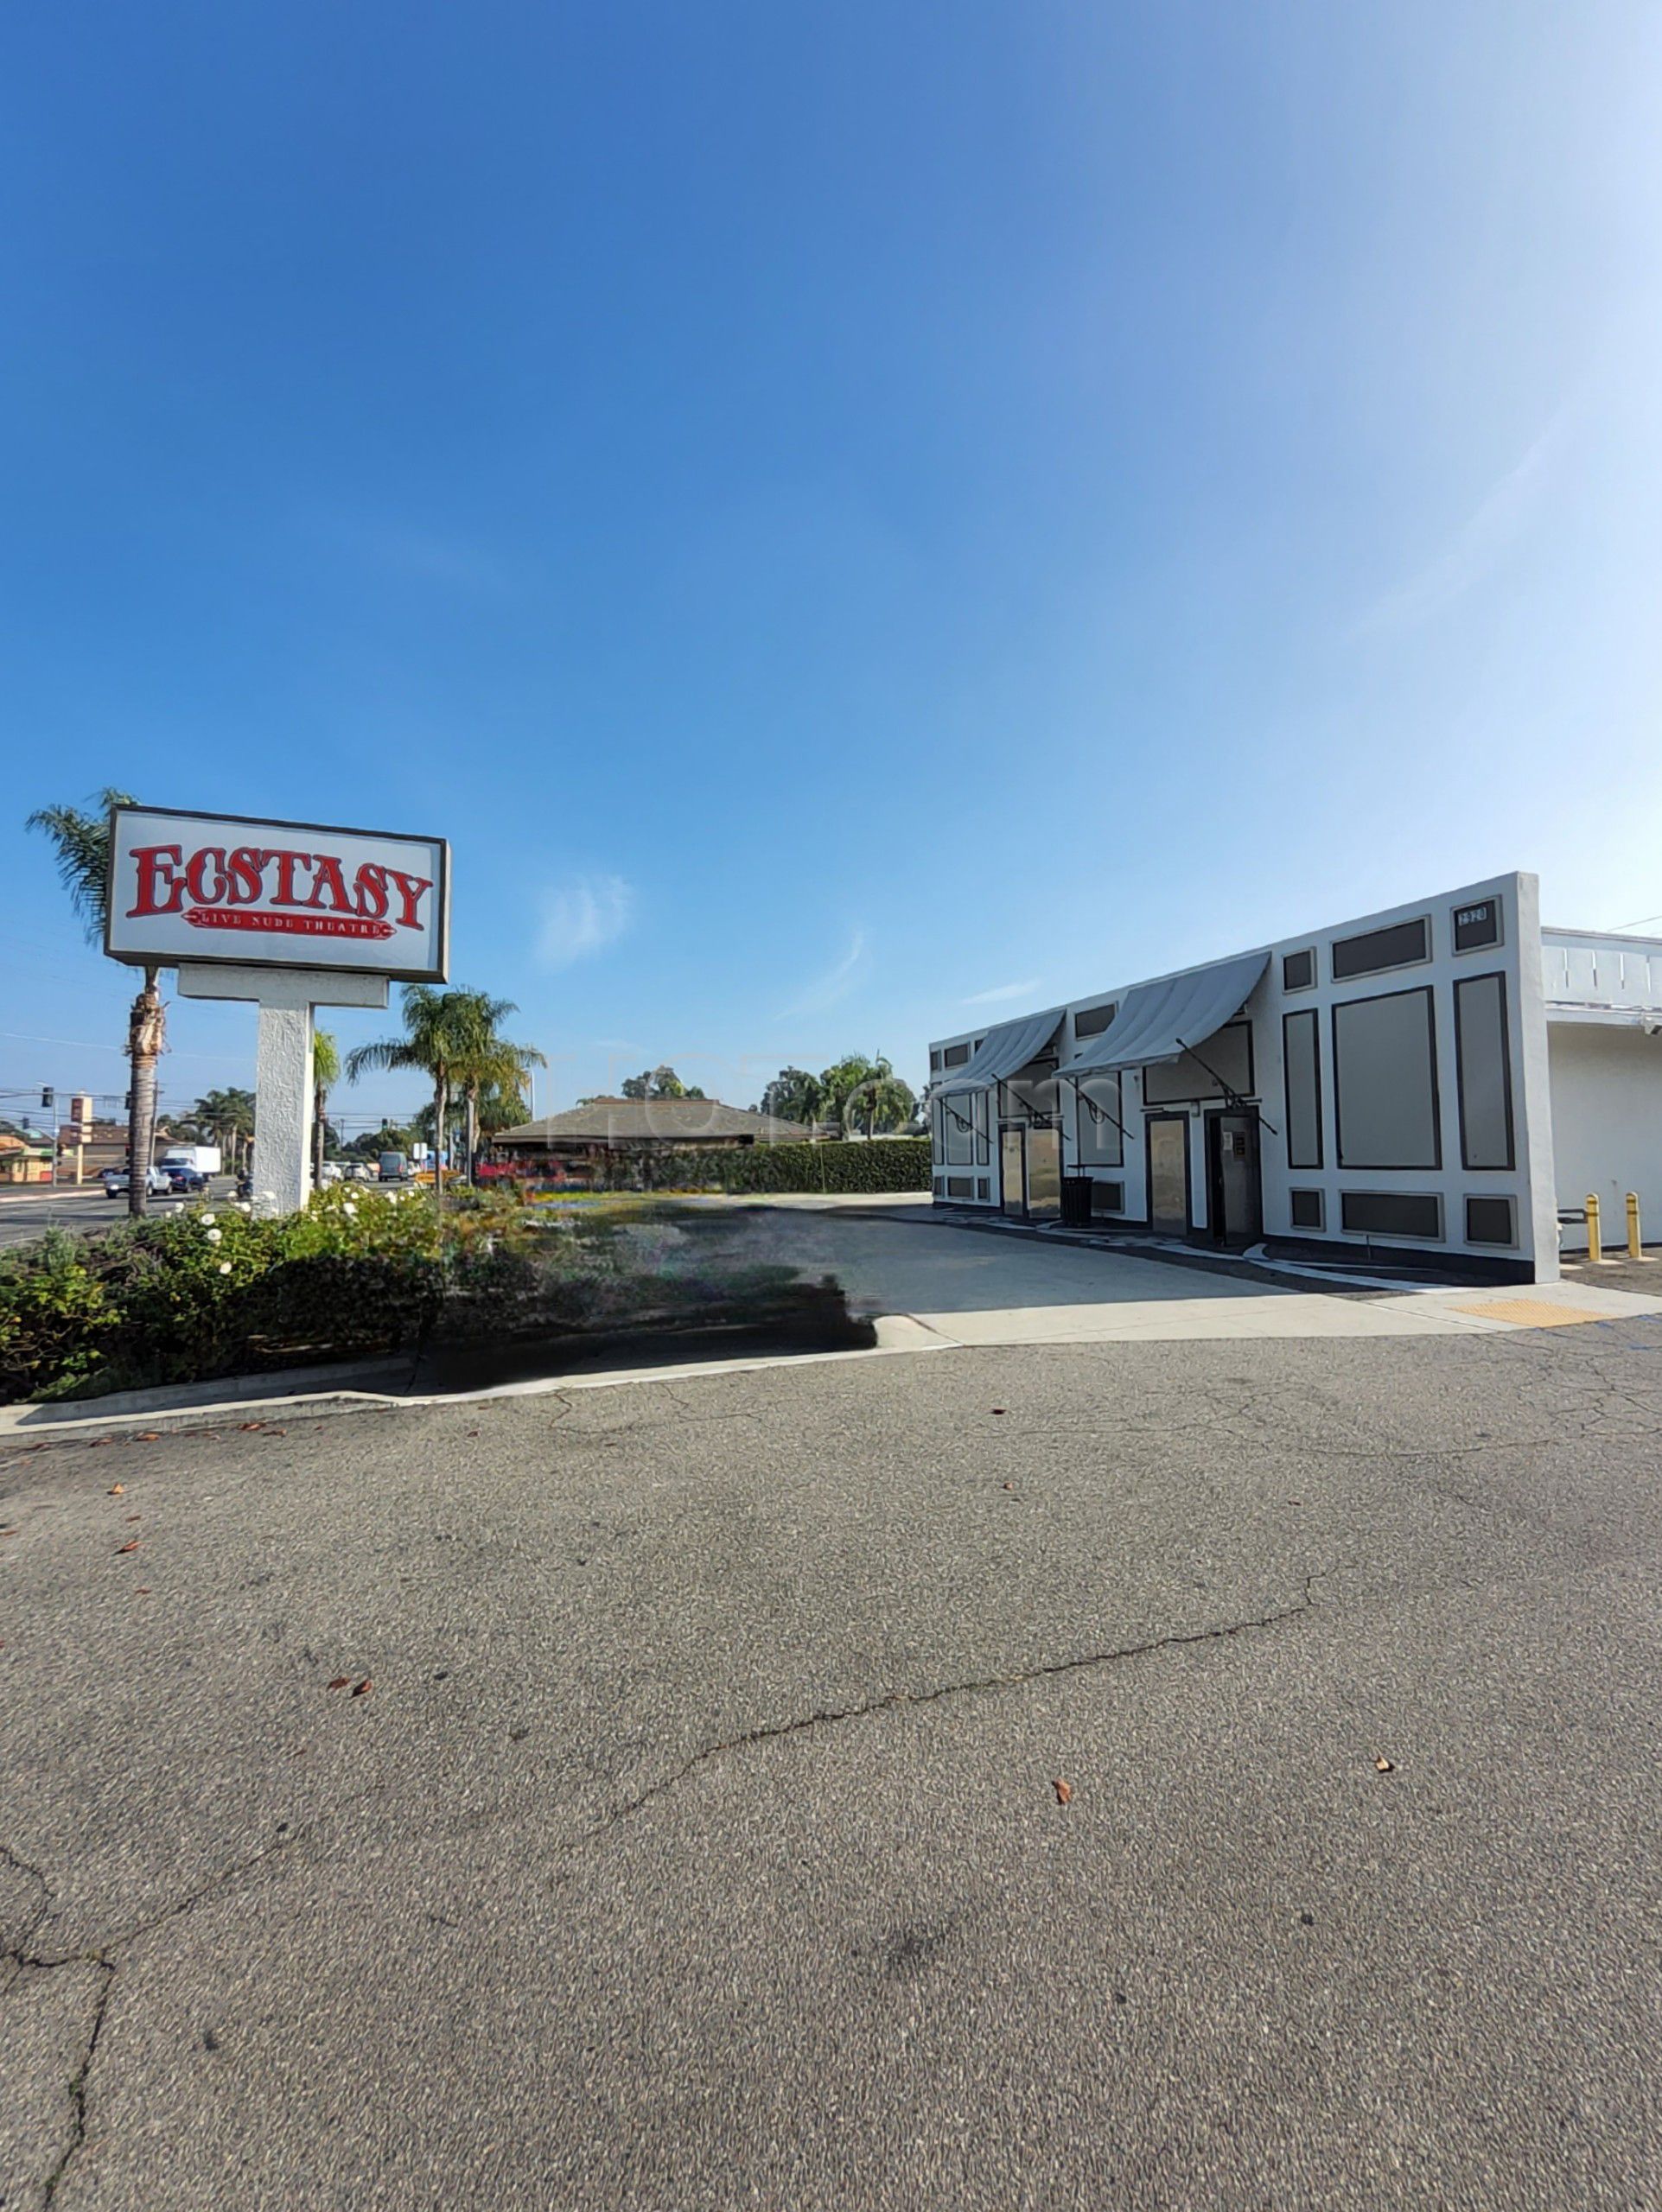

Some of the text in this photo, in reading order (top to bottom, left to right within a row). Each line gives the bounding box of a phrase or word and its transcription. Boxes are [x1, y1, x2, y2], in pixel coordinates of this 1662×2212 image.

[126, 844, 434, 931] ECSTASY
[201, 912, 380, 935] LIVE NUDE THEATRE
